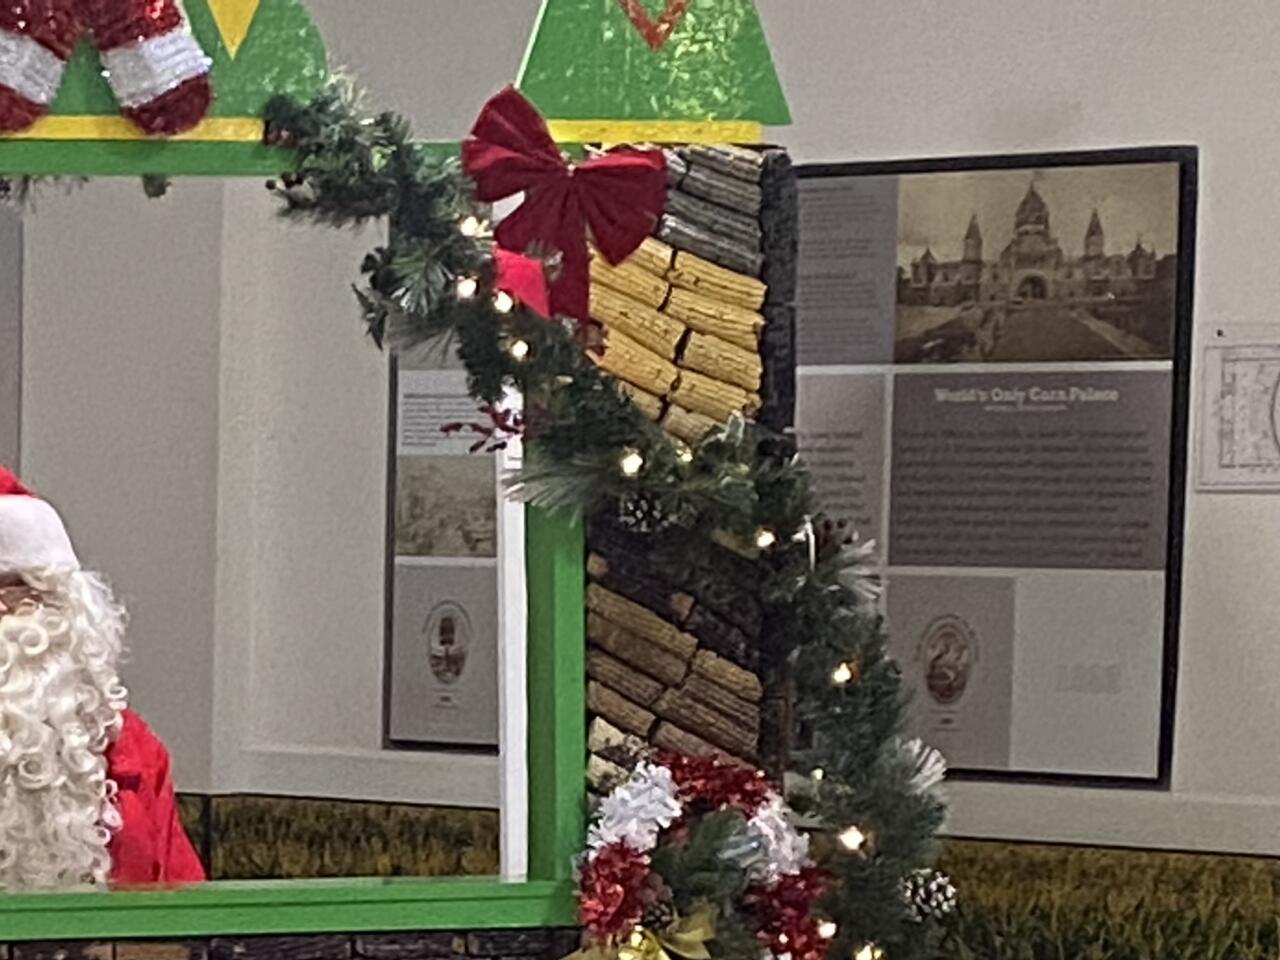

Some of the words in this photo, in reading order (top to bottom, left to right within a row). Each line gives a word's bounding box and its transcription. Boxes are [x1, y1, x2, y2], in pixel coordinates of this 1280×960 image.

[991, 387, 1025, 408] Only
[1028, 387, 1067, 401] Corn
[1068, 387, 1119, 402] Palace
